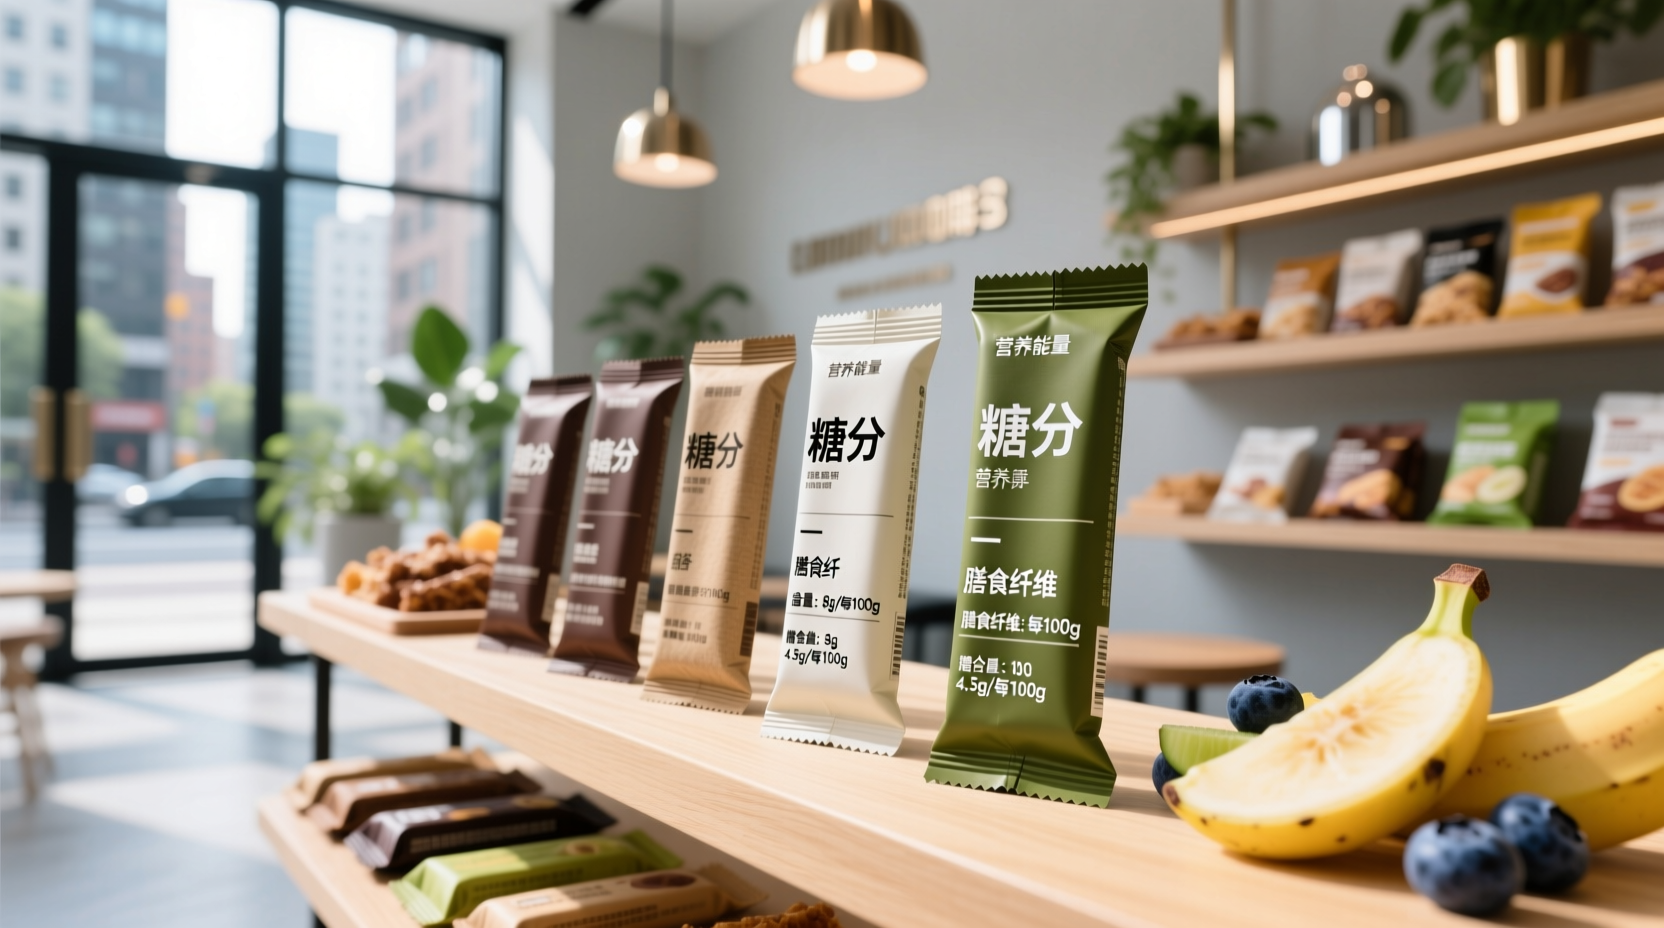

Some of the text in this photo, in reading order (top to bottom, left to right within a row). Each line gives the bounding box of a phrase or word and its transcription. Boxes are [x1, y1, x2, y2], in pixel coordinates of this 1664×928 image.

[995, 333, 1071, 357] 营养能量
[828, 359, 882, 378] 营养能量
[807, 416, 886, 463] 糖分
[977, 401, 1083, 458] 糖分
[586, 437, 639, 474] 糖分
[684, 431, 744, 470] 糖分
[794, 555, 841, 579] 膳食纤
[963, 566, 1058, 598] 膳食纤维
